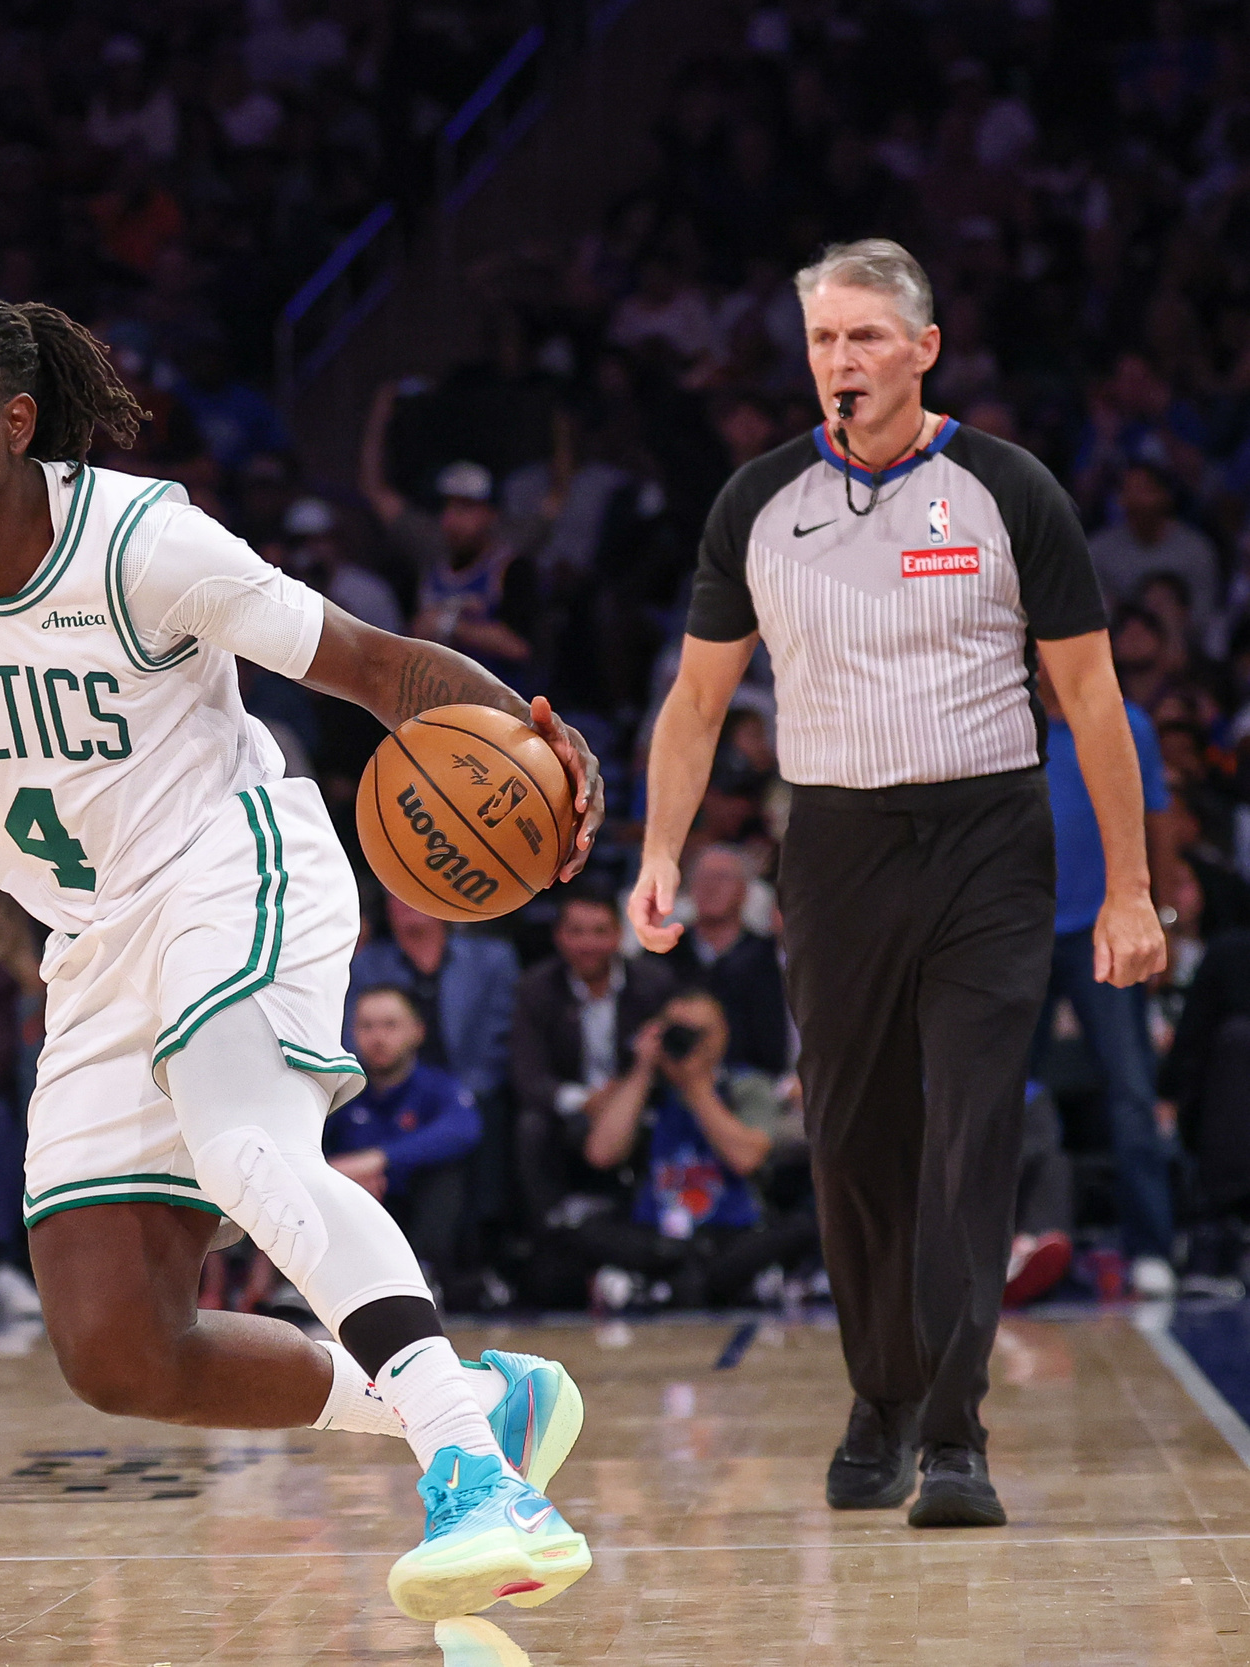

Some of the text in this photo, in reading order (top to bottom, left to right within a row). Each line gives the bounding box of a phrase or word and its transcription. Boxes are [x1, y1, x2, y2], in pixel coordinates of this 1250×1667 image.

[902, 553, 979, 573] Emirates
[41, 611, 107, 630] Amica
[4, 787, 97, 893] 4
[396, 782, 500, 906] Wilson
